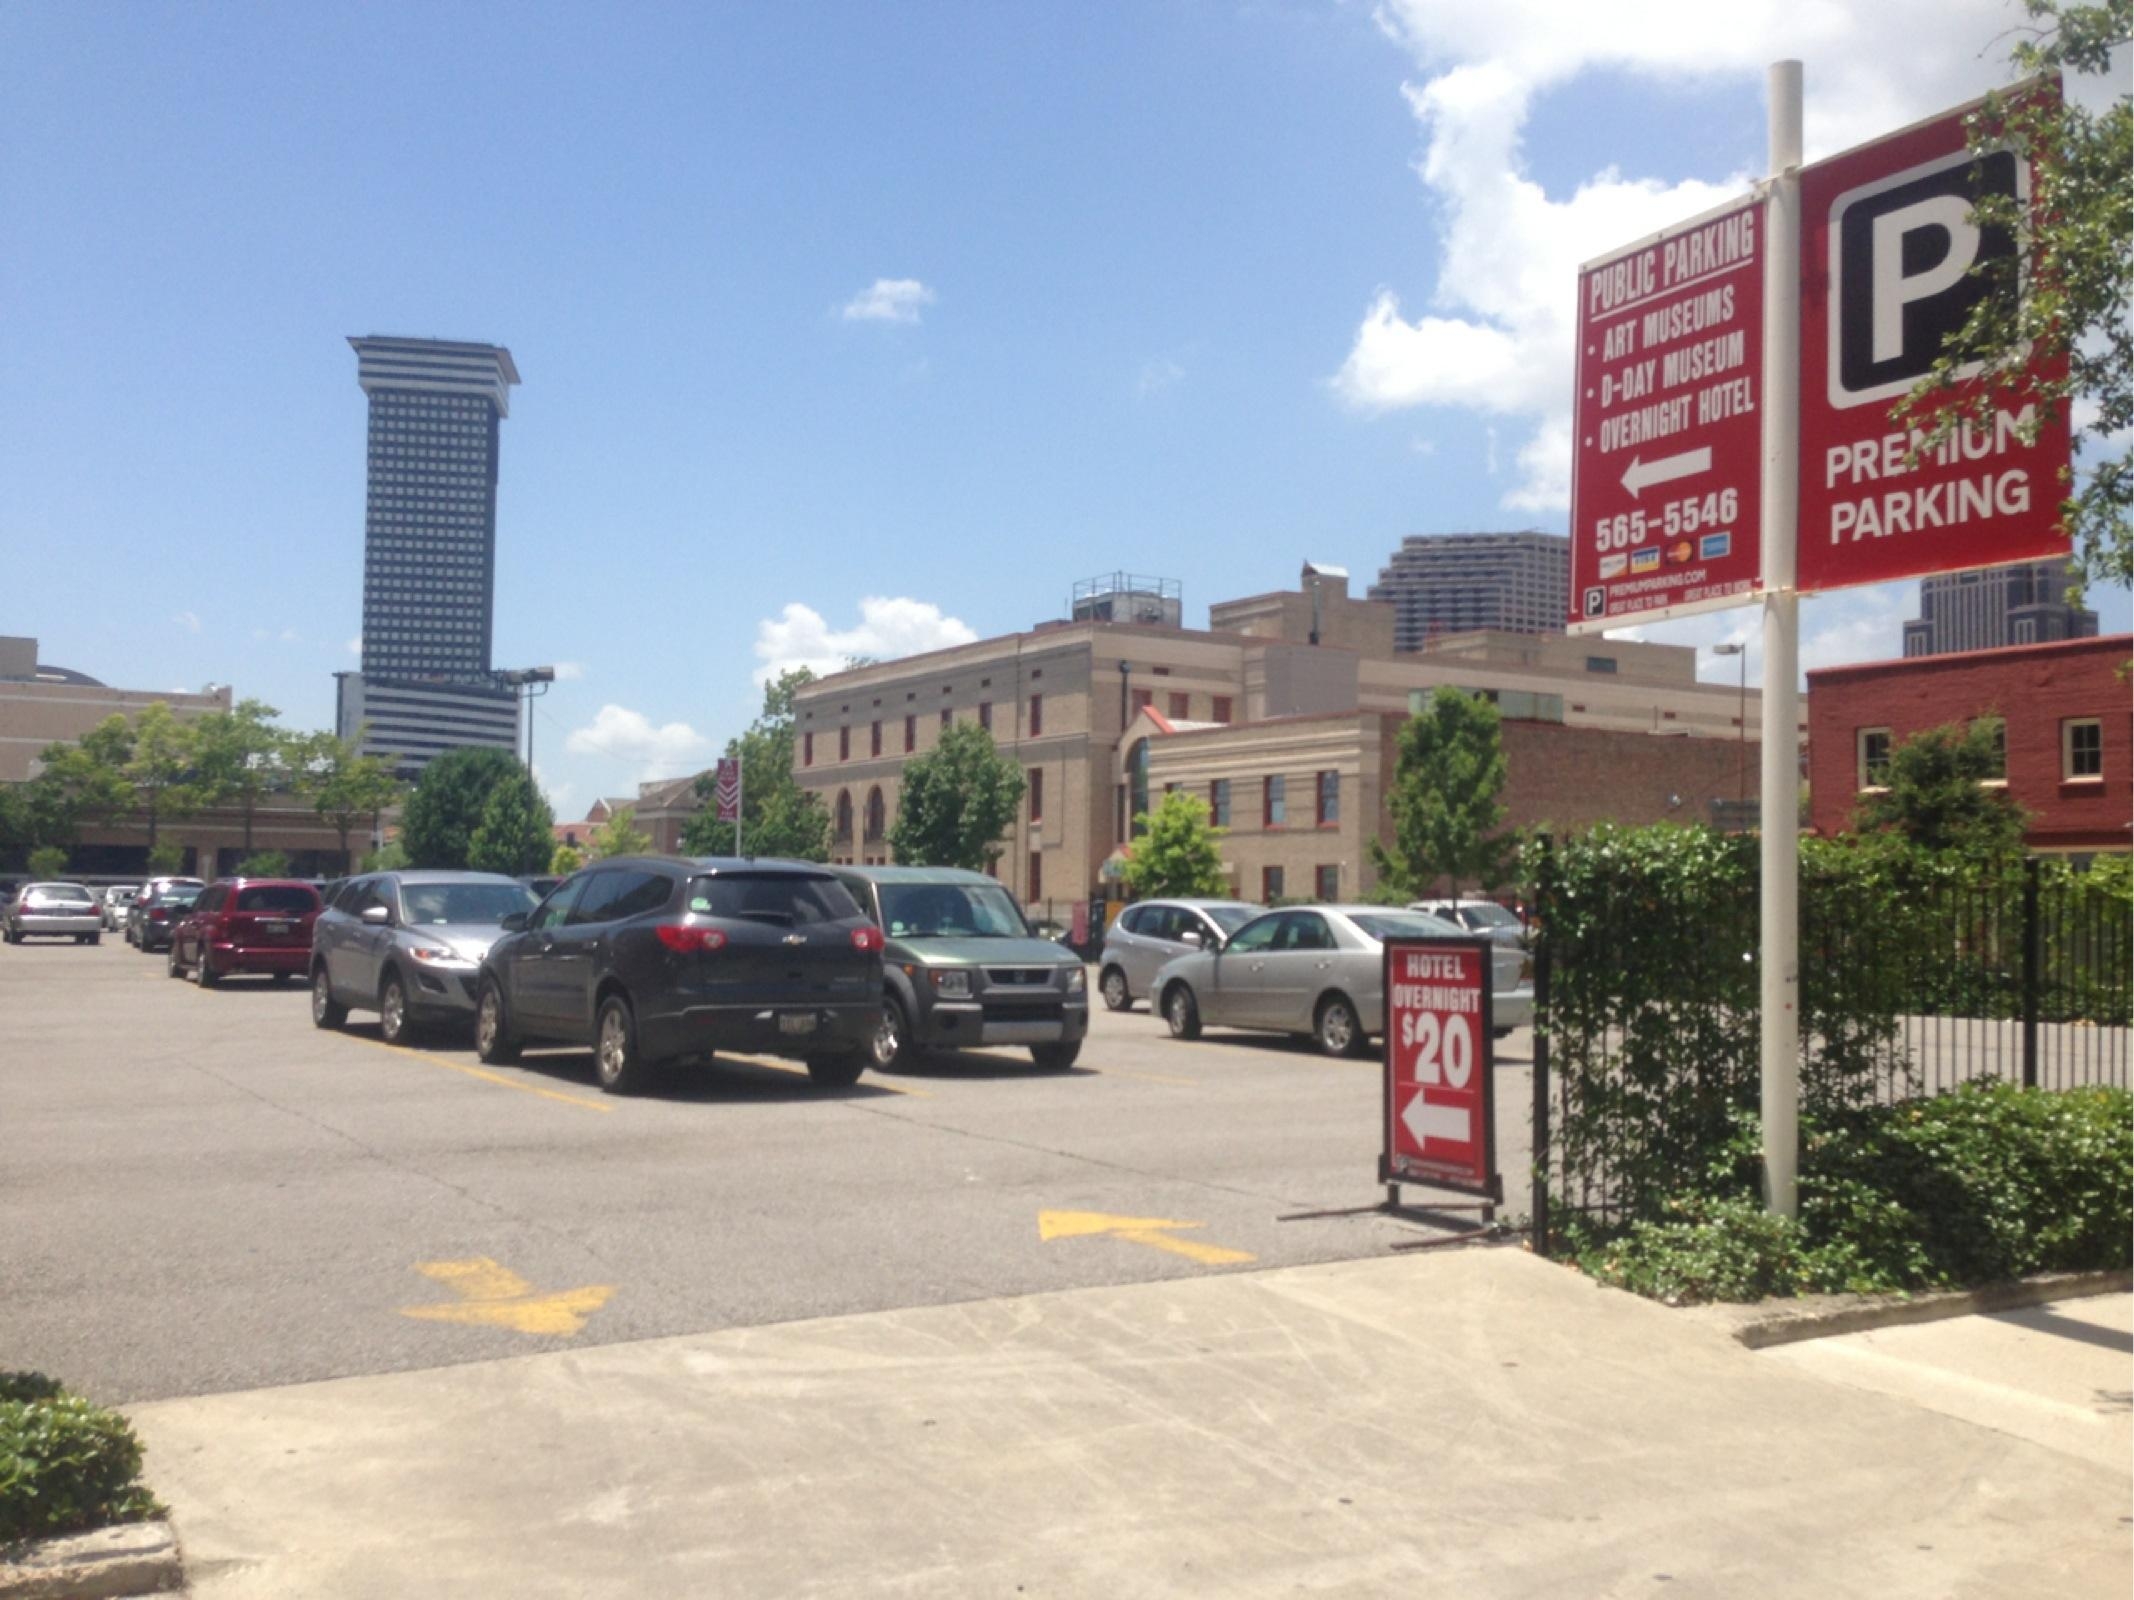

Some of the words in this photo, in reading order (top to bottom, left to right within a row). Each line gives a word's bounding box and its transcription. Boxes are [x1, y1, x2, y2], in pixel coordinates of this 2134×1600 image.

[1590, 251, 1656, 314] PUBLIC
[1664, 210, 1754, 287] PARKING
[1872, 194, 1981, 364] P
[1603, 319, 1637, 363] ART
[1643, 284, 1735, 349] MUSEUMS
[1601, 359, 1656, 409] D-DAY
[1663, 330, 1744, 389] MUSEUM
[1601, 395, 1692, 453] OVERNIGHT
[1698, 376, 1755, 426] HOTEL
[1595, 487, 1738, 552] 565-5546
[1831, 469, 2030, 545] PARKING
[1588, 591, 1601, 615] P
[1393, 985, 1481, 1013] OVERNIGHT
[1407, 954, 1466, 980] HOTEL
[1402, 1012, 1473, 1090] $20
